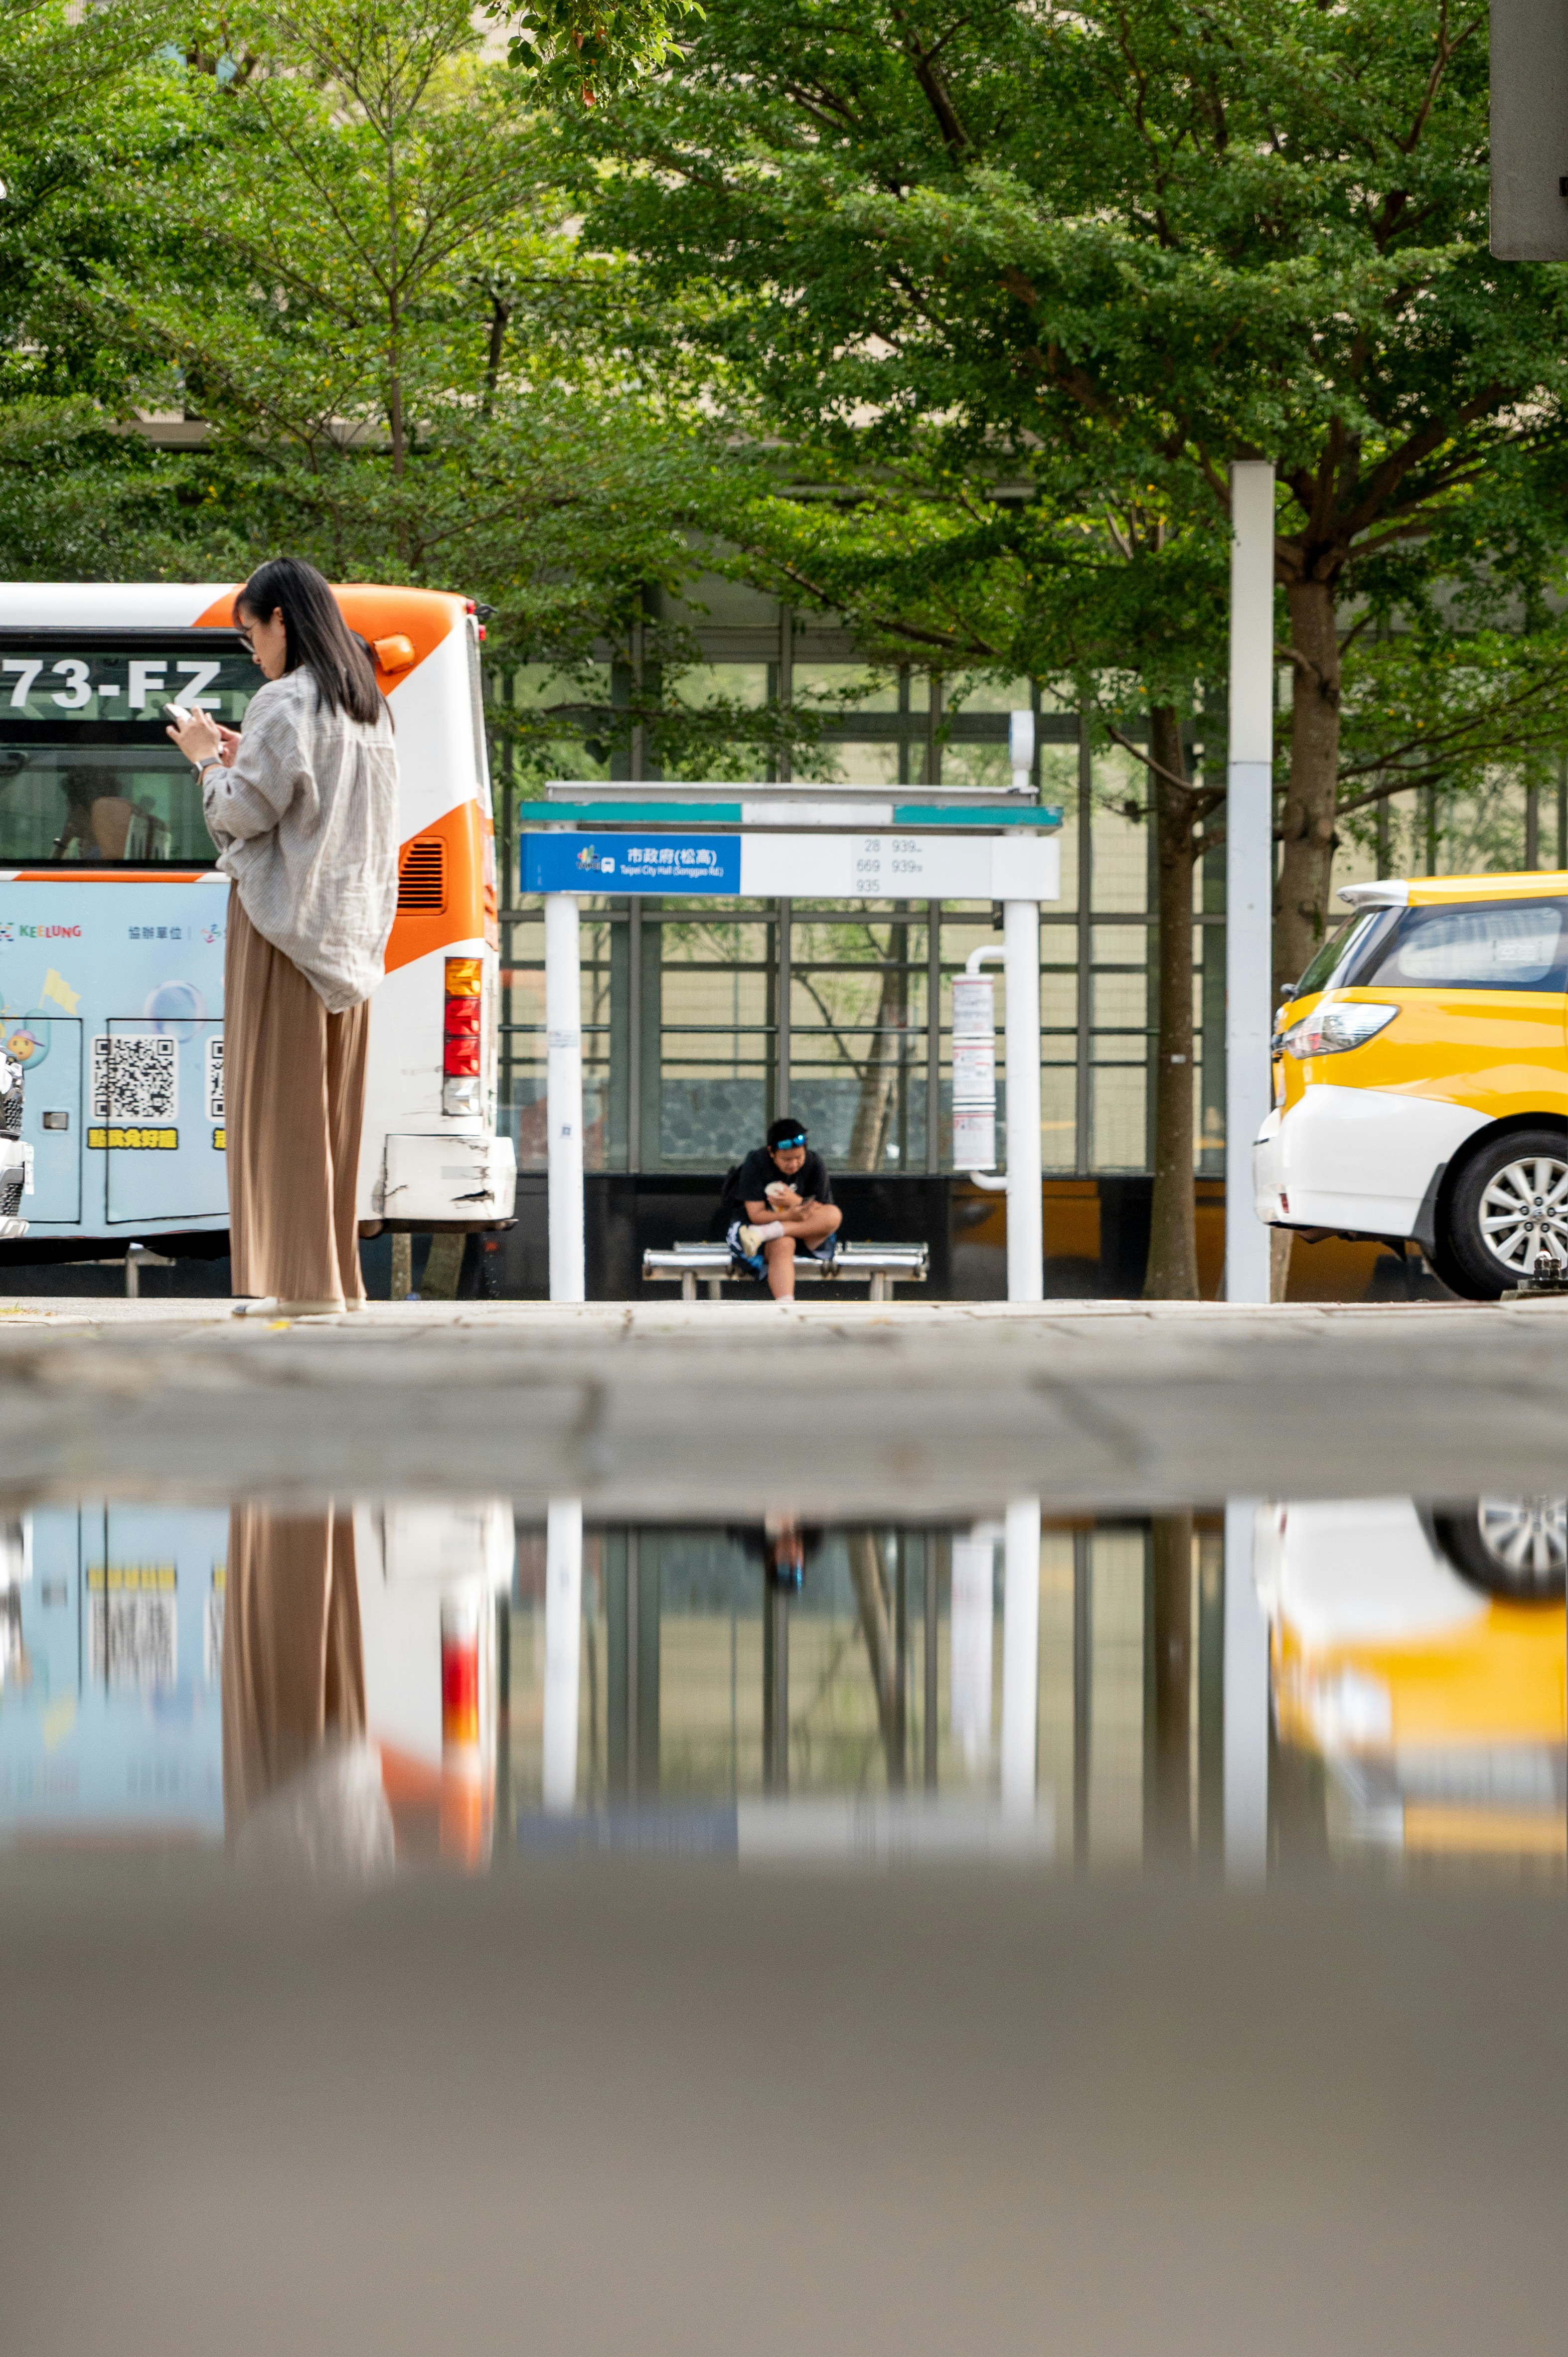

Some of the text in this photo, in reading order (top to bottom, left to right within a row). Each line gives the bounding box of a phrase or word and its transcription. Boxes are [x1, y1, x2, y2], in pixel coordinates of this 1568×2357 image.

[2, 659, 221, 709] 73-FZ
[865, 839, 922, 853] 28 939
[627, 848, 717, 866] 市政府(松高)
[621, 865, 642, 876] Taipei
[642, 865, 656, 877] City
[657, 865, 672, 875] Hall
[856, 859, 923, 873] 669 939
[856, 879, 880, 892] 935
[19, 925, 82, 938] KEELUNG
